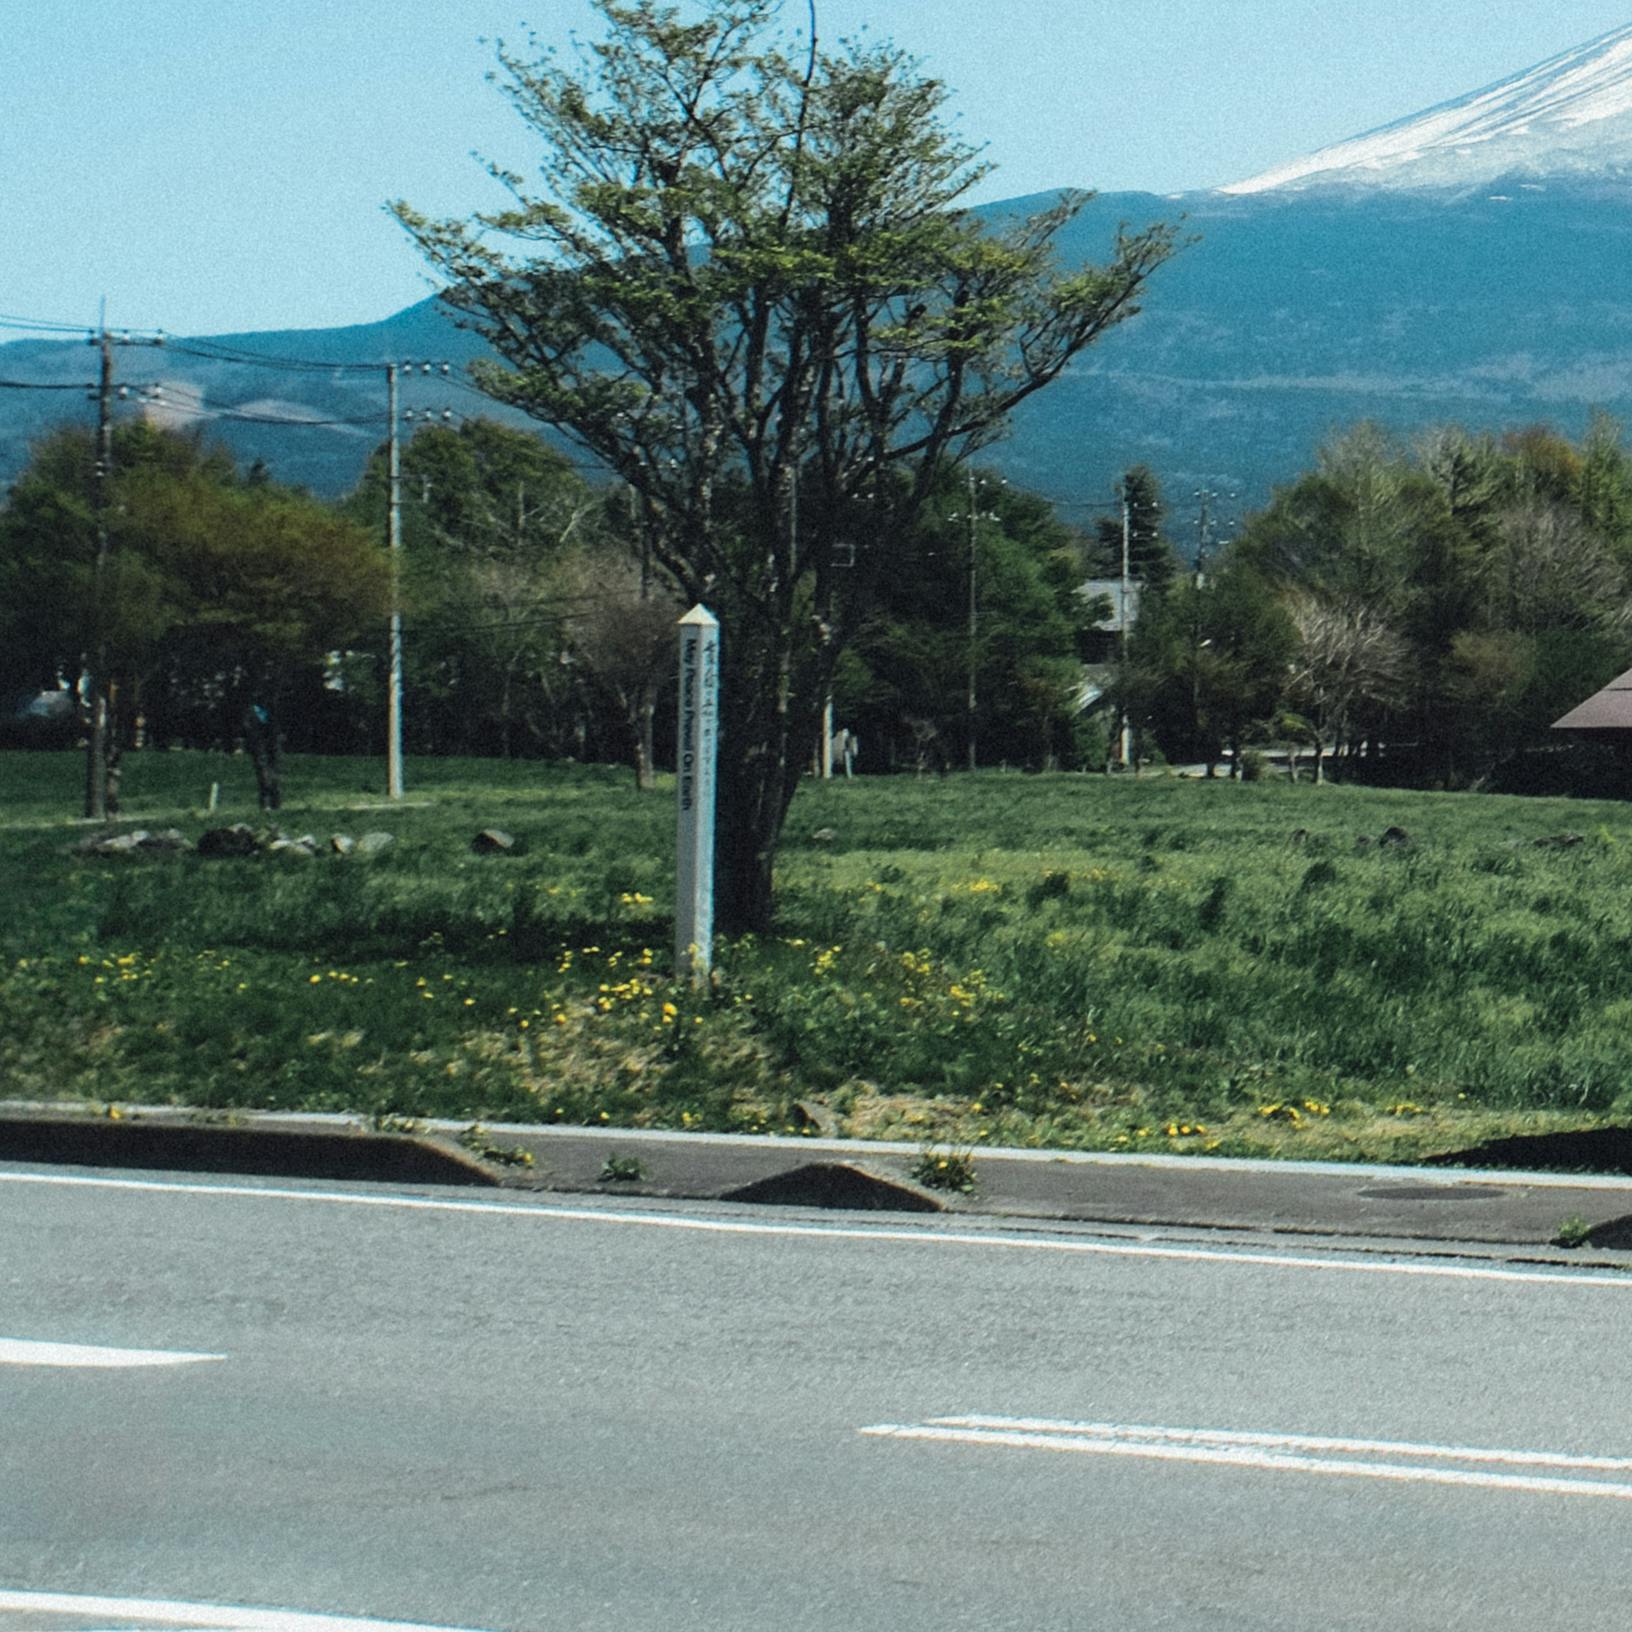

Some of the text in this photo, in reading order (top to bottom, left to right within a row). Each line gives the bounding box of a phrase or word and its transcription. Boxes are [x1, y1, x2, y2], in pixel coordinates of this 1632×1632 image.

[684, 639, 697, 665] May
[684, 668, 696, 707] Peace
[683, 754, 695, 772] On
[682, 776, 694, 811] Earth
